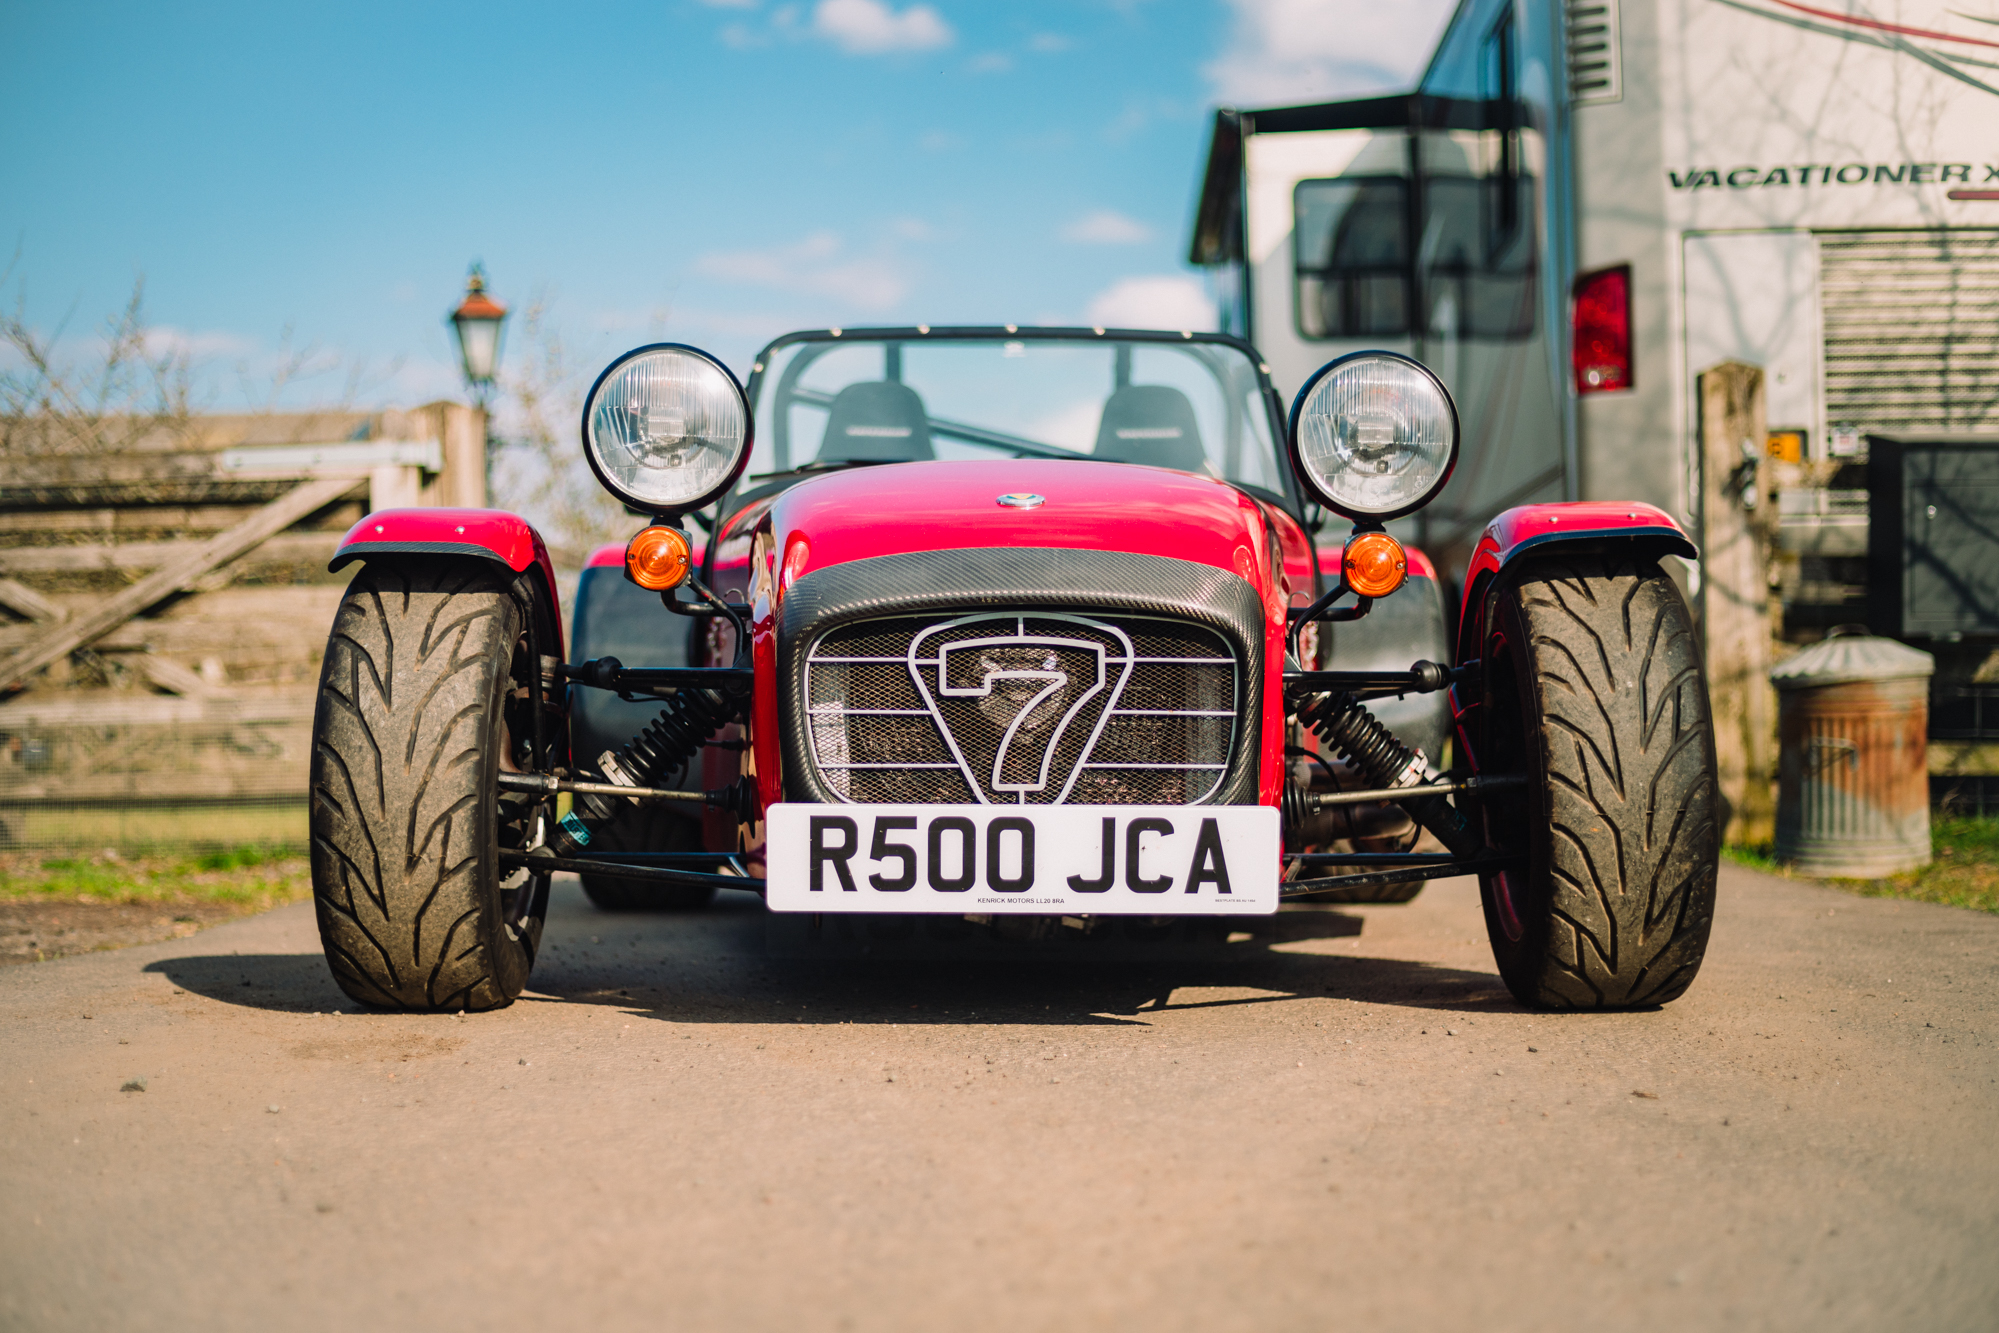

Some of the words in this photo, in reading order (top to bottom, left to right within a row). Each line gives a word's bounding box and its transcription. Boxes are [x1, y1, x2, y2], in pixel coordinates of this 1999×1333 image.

[1668, 164, 1971, 188] VACATIONER
[939, 635, 1105, 791] 7
[809, 815, 1036, 893] R500
[1066, 816, 1233, 894] JCA
